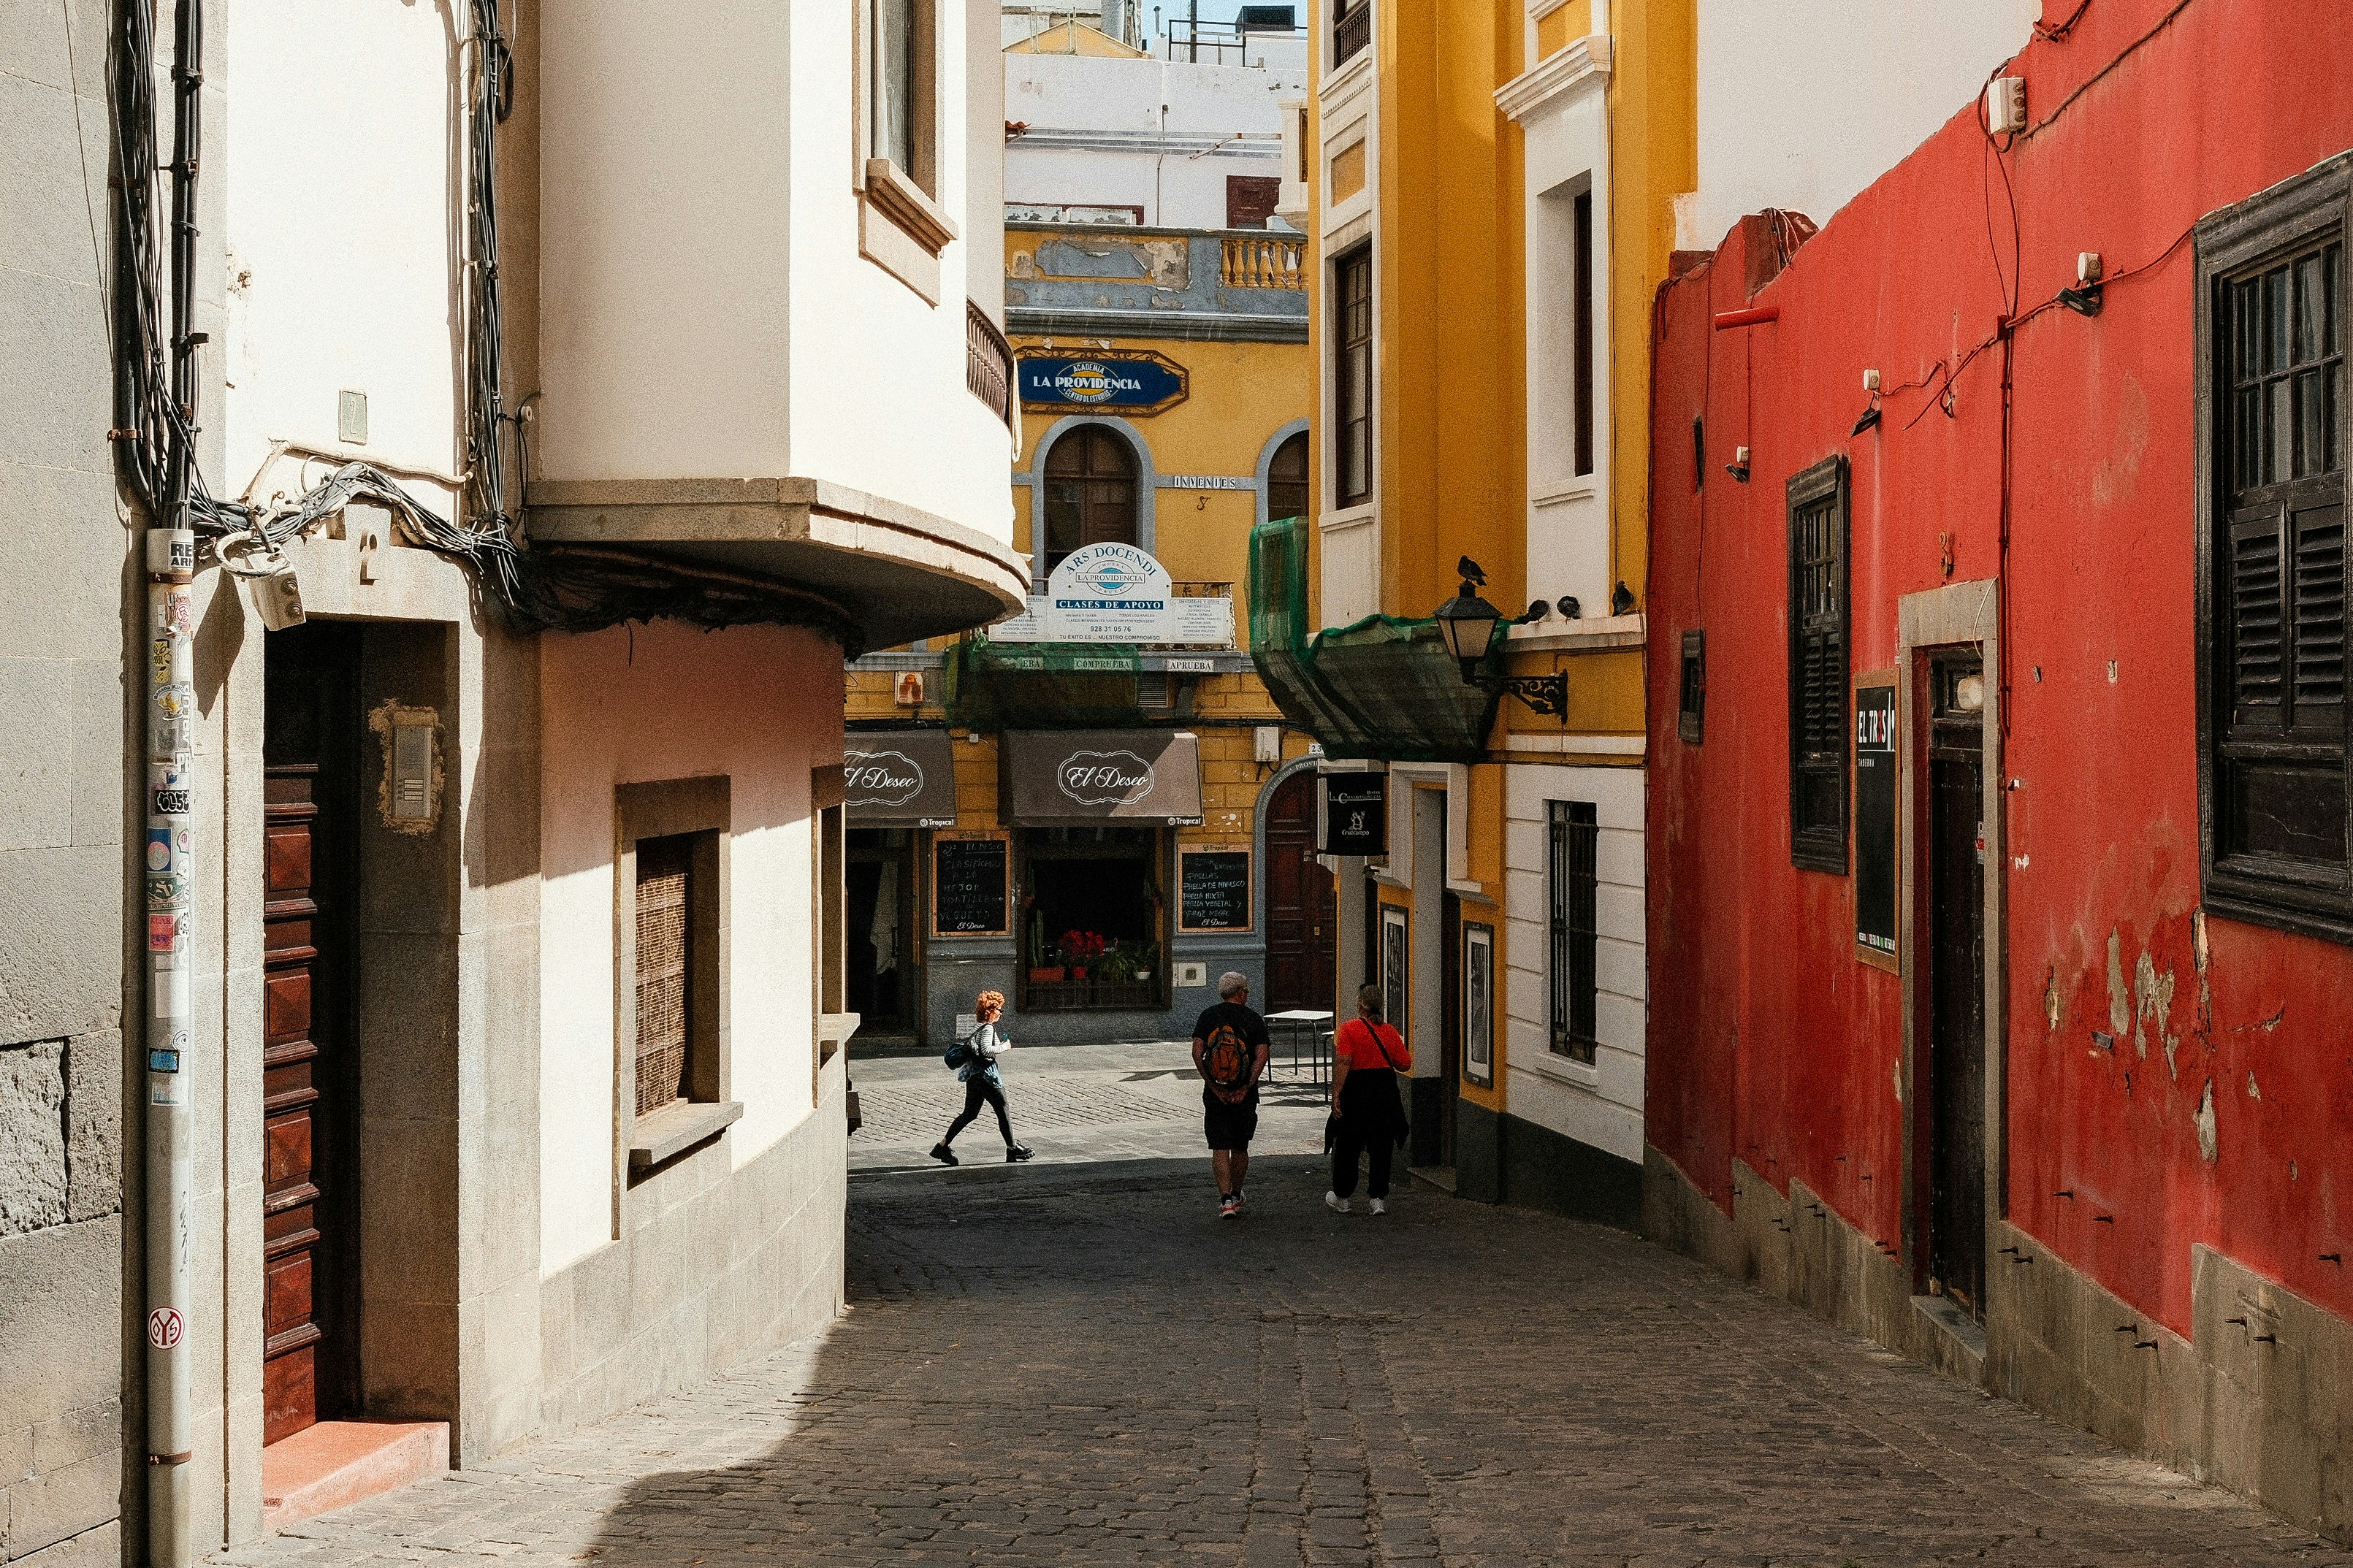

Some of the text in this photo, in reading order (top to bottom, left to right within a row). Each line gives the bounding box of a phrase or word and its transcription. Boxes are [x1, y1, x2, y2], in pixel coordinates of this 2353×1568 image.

[1073, 363, 1104, 374] ACADEMIA
[1033, 376, 1142, 390] LA PROVIDENCIA
[1065, 389, 1083, 402] CENTRO
[1090, 390, 1111, 402] ESTUDIOS
[1066, 546, 1157, 576] ARS DOCENDI
[1090, 574, 1143, 582] PROVIDENCIA
[1059, 600, 1100, 608] CLASES
[1124, 601, 1161, 609] APOYO
[1076, 659, 1130, 668] COMPRUEBA
[1170, 661, 1211, 670] APRUEBA
[1858, 709, 1886, 743] EL TR3S
[1311, 745, 1322, 753] 23
[844, 767, 918, 788] l Deseo
[1067, 767, 1149, 788] El Deseo
[957, 922, 966, 930] El
